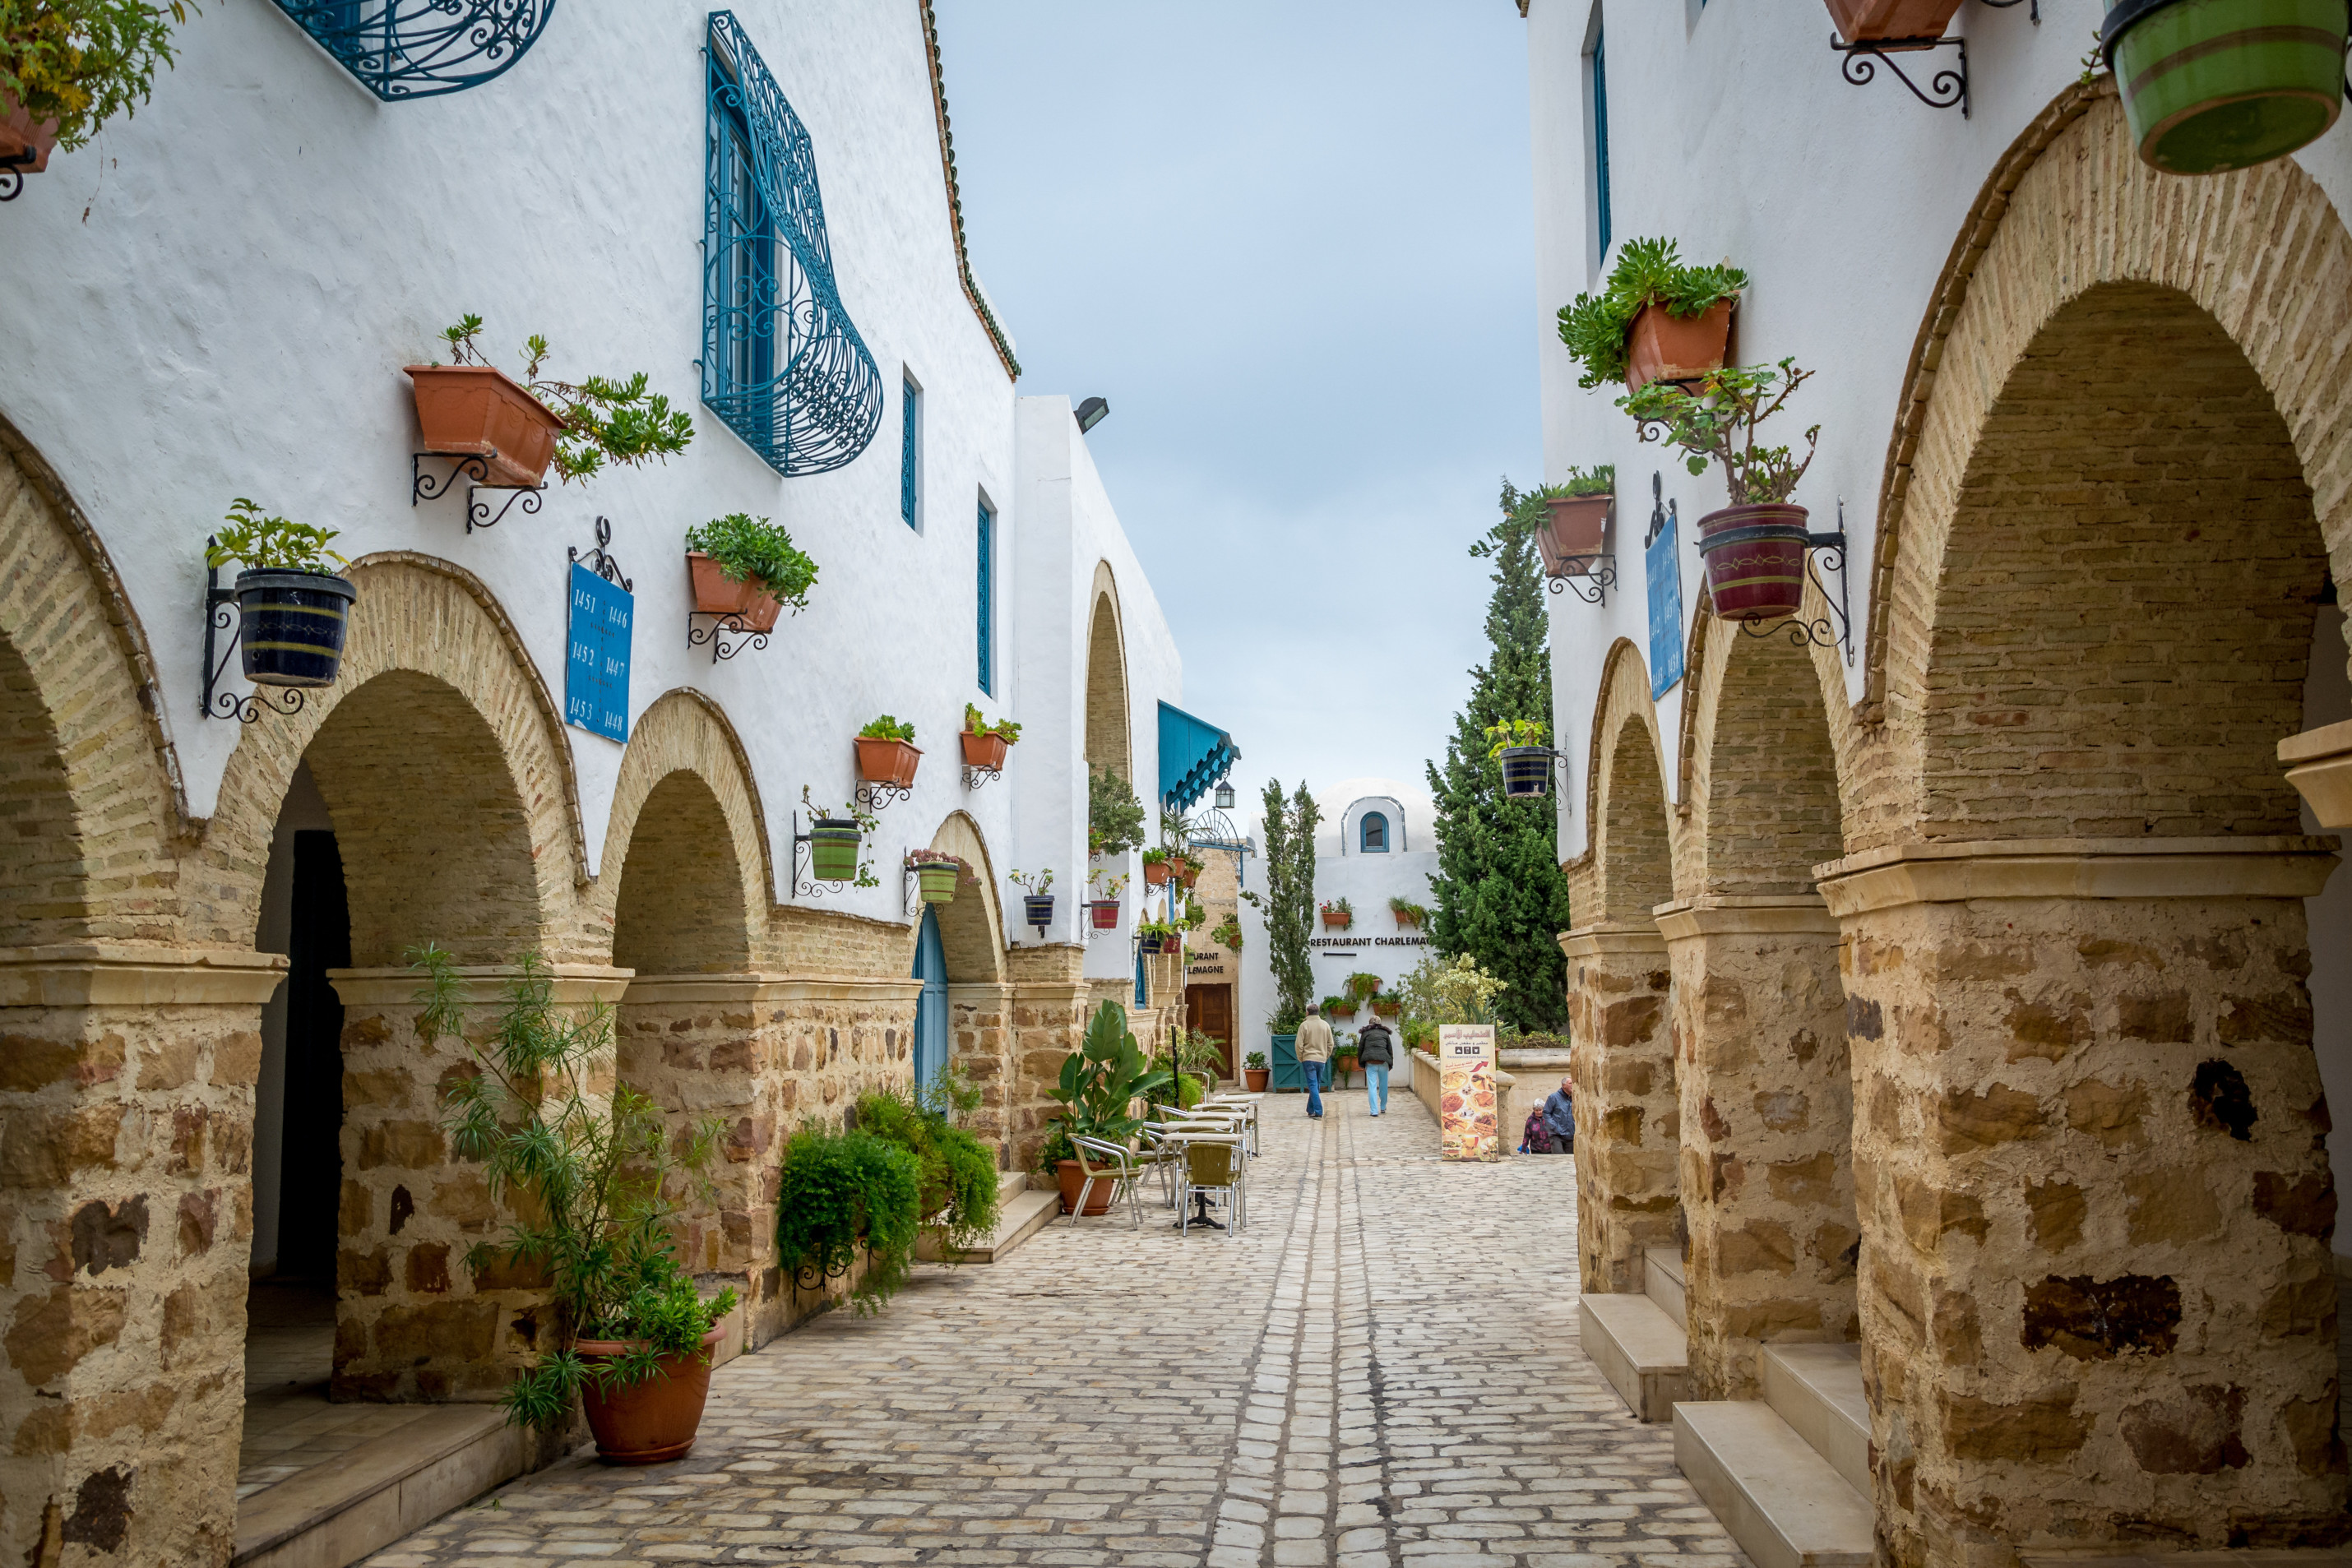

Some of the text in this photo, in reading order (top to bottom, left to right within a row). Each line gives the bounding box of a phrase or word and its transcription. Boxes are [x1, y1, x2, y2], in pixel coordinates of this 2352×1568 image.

[574, 589, 596, 613] 1451
[609, 606, 627, 628] 1446
[572, 641, 595, 667] 1452
[605, 657, 625, 678] 1447
[570, 696, 593, 720] 1453
[604, 711, 623, 732] 1448
[1310, 938, 1372, 946] RESTAURANT
